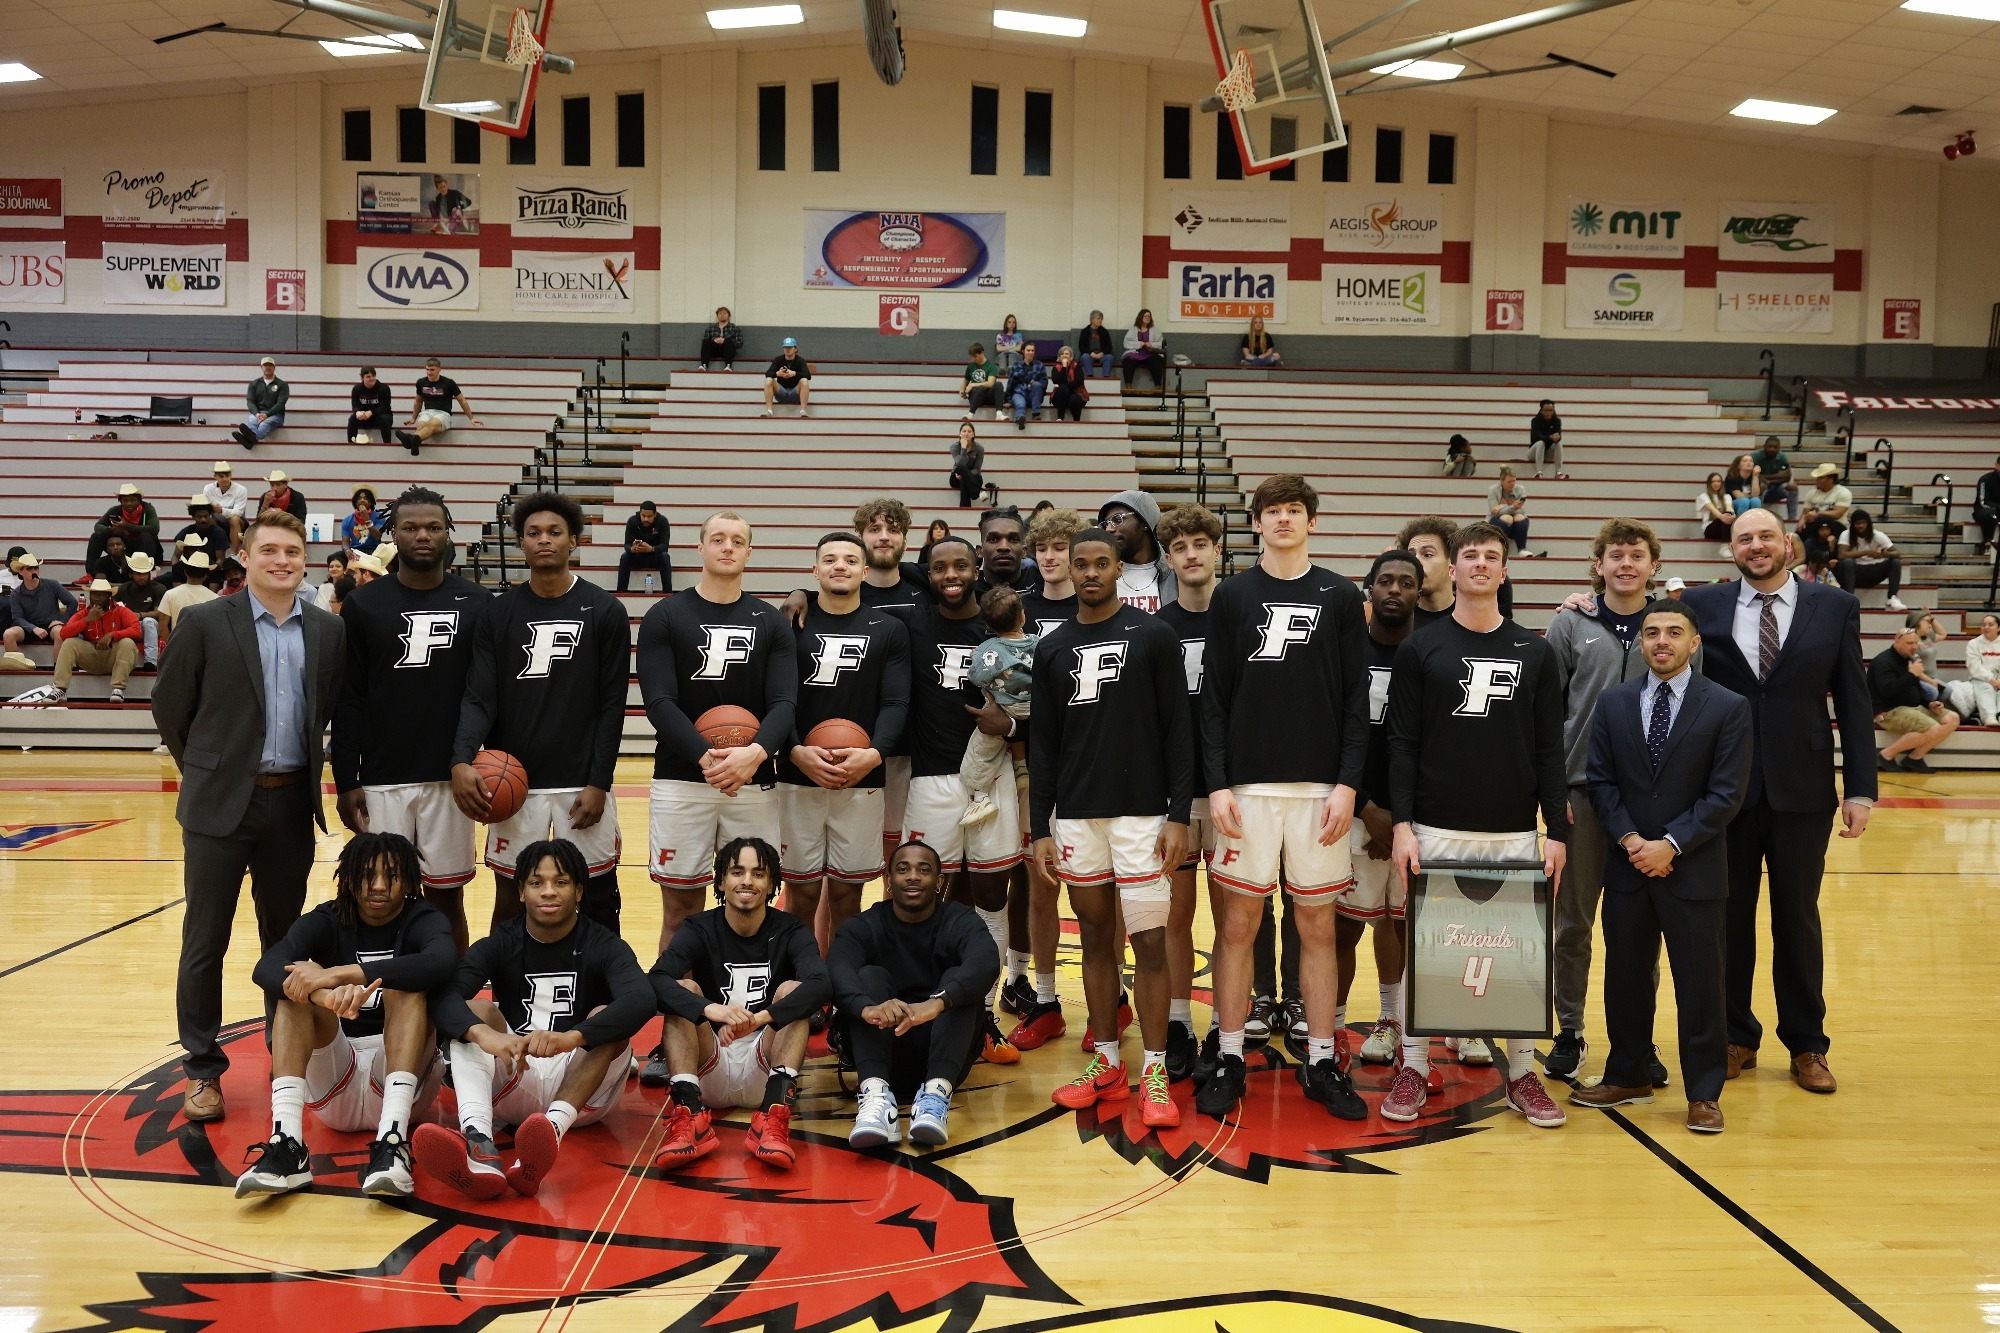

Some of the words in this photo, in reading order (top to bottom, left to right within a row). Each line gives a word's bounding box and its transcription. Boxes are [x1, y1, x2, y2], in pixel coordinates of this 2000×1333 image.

[103, 170, 165, 195] Promo
[7, 197, 52, 210] JOURNAL
[145, 179, 208, 214] Depot
[518, 193, 567, 218] Pizza
[570, 191, 627, 221] Ranch
[880, 213, 922, 231] NAIA
[1329, 218, 1370, 230] AEGIS
[1389, 219, 1438, 231] GROUP
[1723, 216, 1801, 235] KRUSE
[106, 256, 222, 272] SUPPLEMENT
[843, 265, 900, 273] RESPONSIBILITY
[915, 256, 946, 264] RESPECT
[267, 271, 304, 280] SECTION
[385, 266, 453, 290] IMA
[515, 257, 630, 299] PHOENIX
[909, 266, 968, 274] SPORTSMANSHIP
[1181, 265, 1275, 299] Farha
[276, 282, 295, 306] B
[515, 291, 541, 299] HOME
[581, 292, 619, 300] HOSPICE
[881, 296, 919, 305] SECTION
[1488, 290, 1523, 300] SECTION
[1747, 293, 1831, 306] SHELDEN
[1184, 303, 1271, 316] ROOFING
[1496, 303, 1514, 325] D
[1884, 300, 1920, 309] SECTION
[890, 307, 909, 330] C
[1593, 310, 1654, 322] SANDIFER
[1894, 312, 1911, 334] E
[394, 610, 459, 668] F
[1248, 602, 1322, 661] F
[516, 620, 584, 679] F
[690, 624, 756, 681] F
[803, 633, 871, 686] F
[1068, 640, 1129, 706] F
[1451, 657, 1523, 717] F
[711, 734, 752, 746] SPALDIN
[496, 838, 510, 854] F
[1060, 845, 1075, 862] F
[658, 848, 677, 866] F
[1222, 848, 1241, 866] F
[1443, 923, 1515, 949] Friends
[720, 960, 772, 1012] F
[1462, 956, 1494, 997] 4
[515, 972, 577, 1036] F
